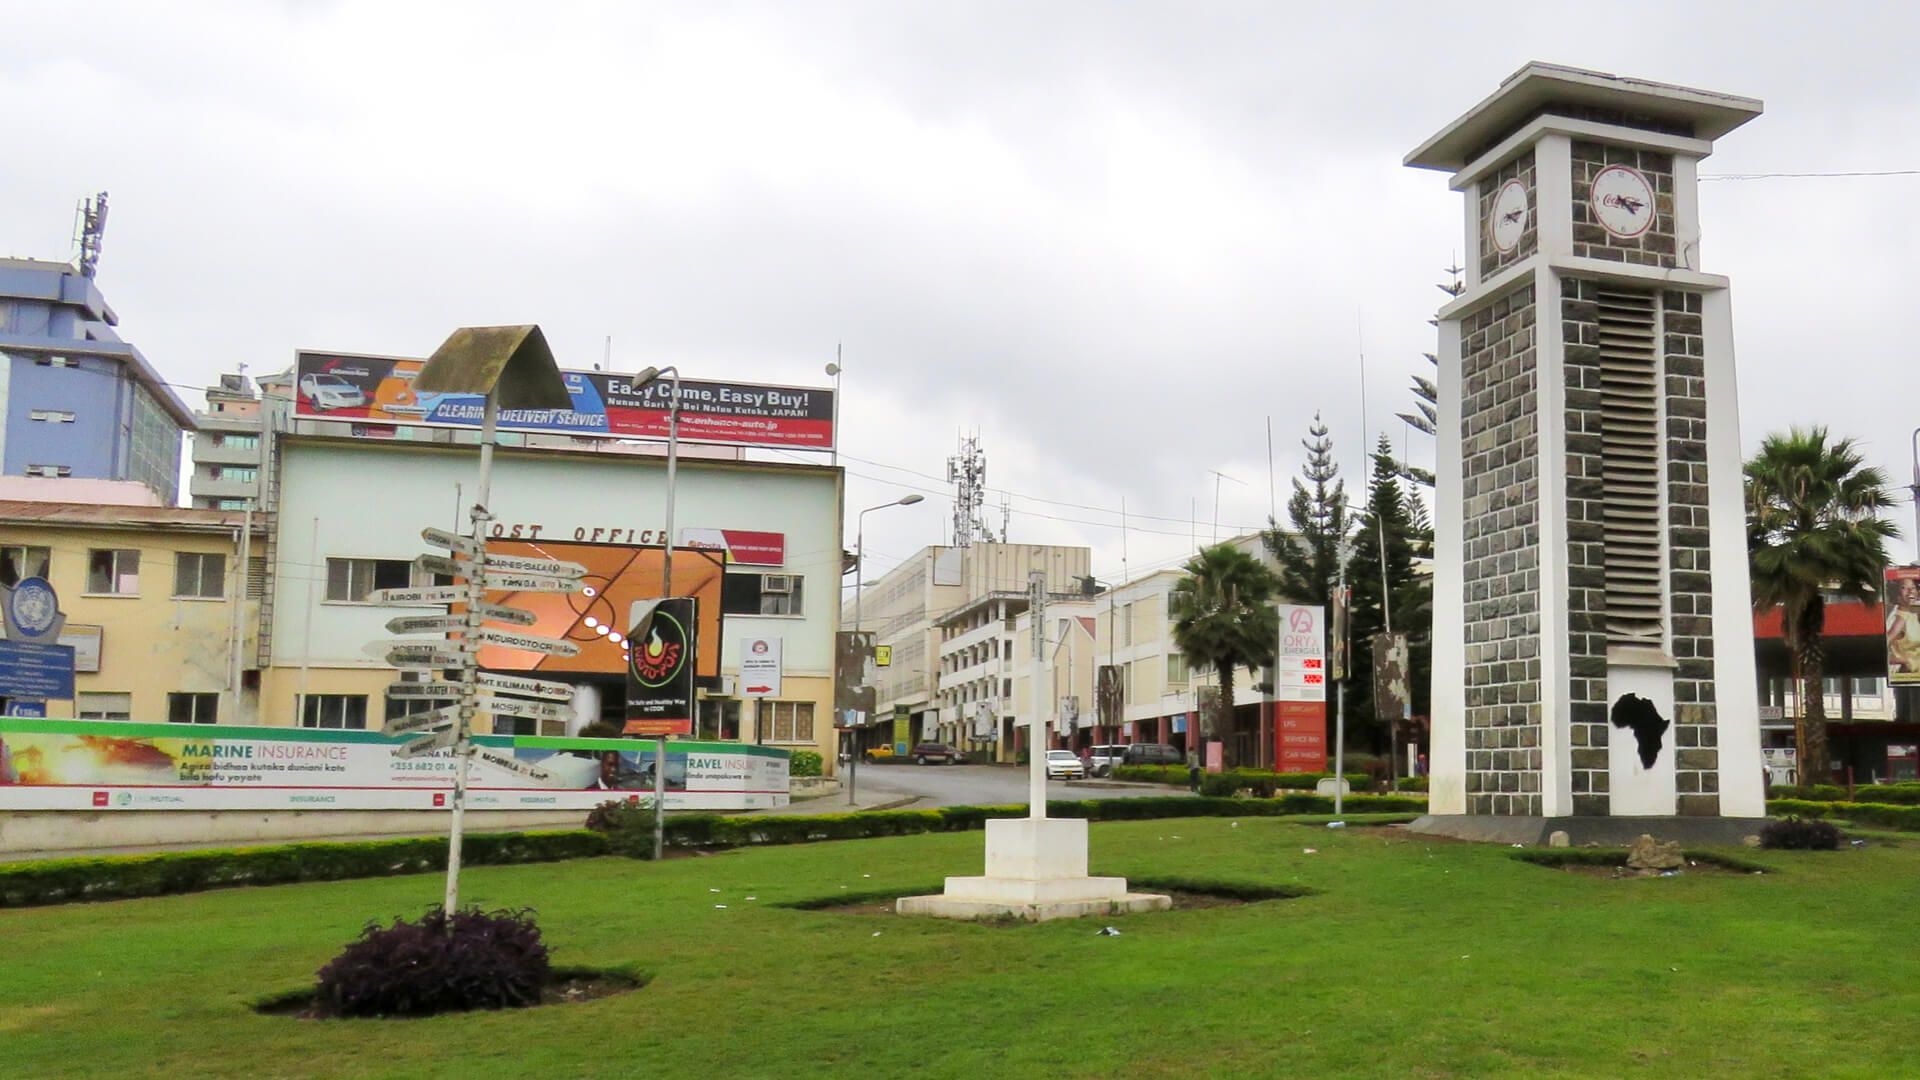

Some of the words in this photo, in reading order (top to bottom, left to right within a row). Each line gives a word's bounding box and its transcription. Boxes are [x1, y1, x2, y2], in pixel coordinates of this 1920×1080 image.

[719, 390, 763, 408] Easy
[767, 391, 809, 409] Buy!
[437, 403, 488, 419] CLEARIN
[557, 412, 604, 426] SERVICE
[771, 409, 808, 418] JAPAN!
[492, 524, 542, 538] OST
[574, 527, 668, 544] OFFICE
[440, 591, 455, 599] km
[182, 744, 253, 759] MARINE
[257, 745, 348, 760] INSURANCE
[289, 795, 336, 804] INSURANCE
